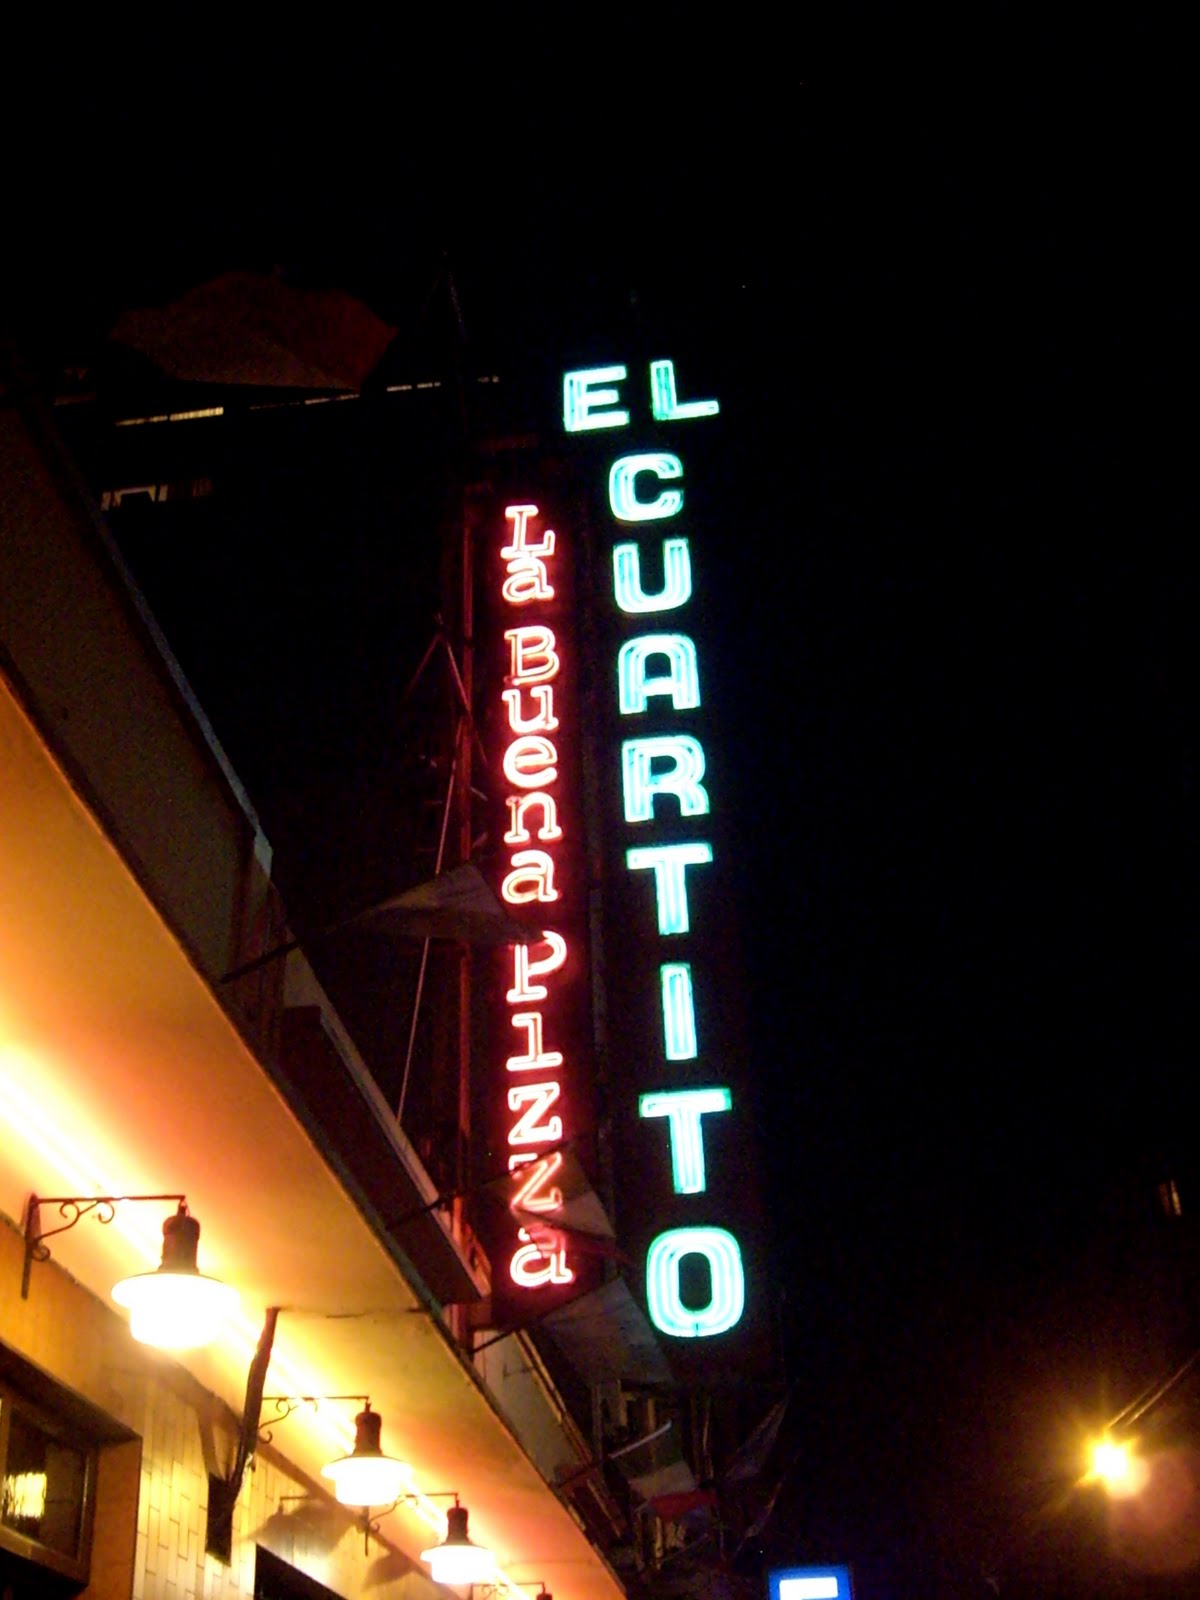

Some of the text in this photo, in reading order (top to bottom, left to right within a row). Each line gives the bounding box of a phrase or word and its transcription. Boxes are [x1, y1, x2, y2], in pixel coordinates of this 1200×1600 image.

[563, 360, 719, 432] EL
[500, 504, 556, 605] La
[501, 625, 563, 905] Buena
[609, 453, 745, 1337] CUARTITO
